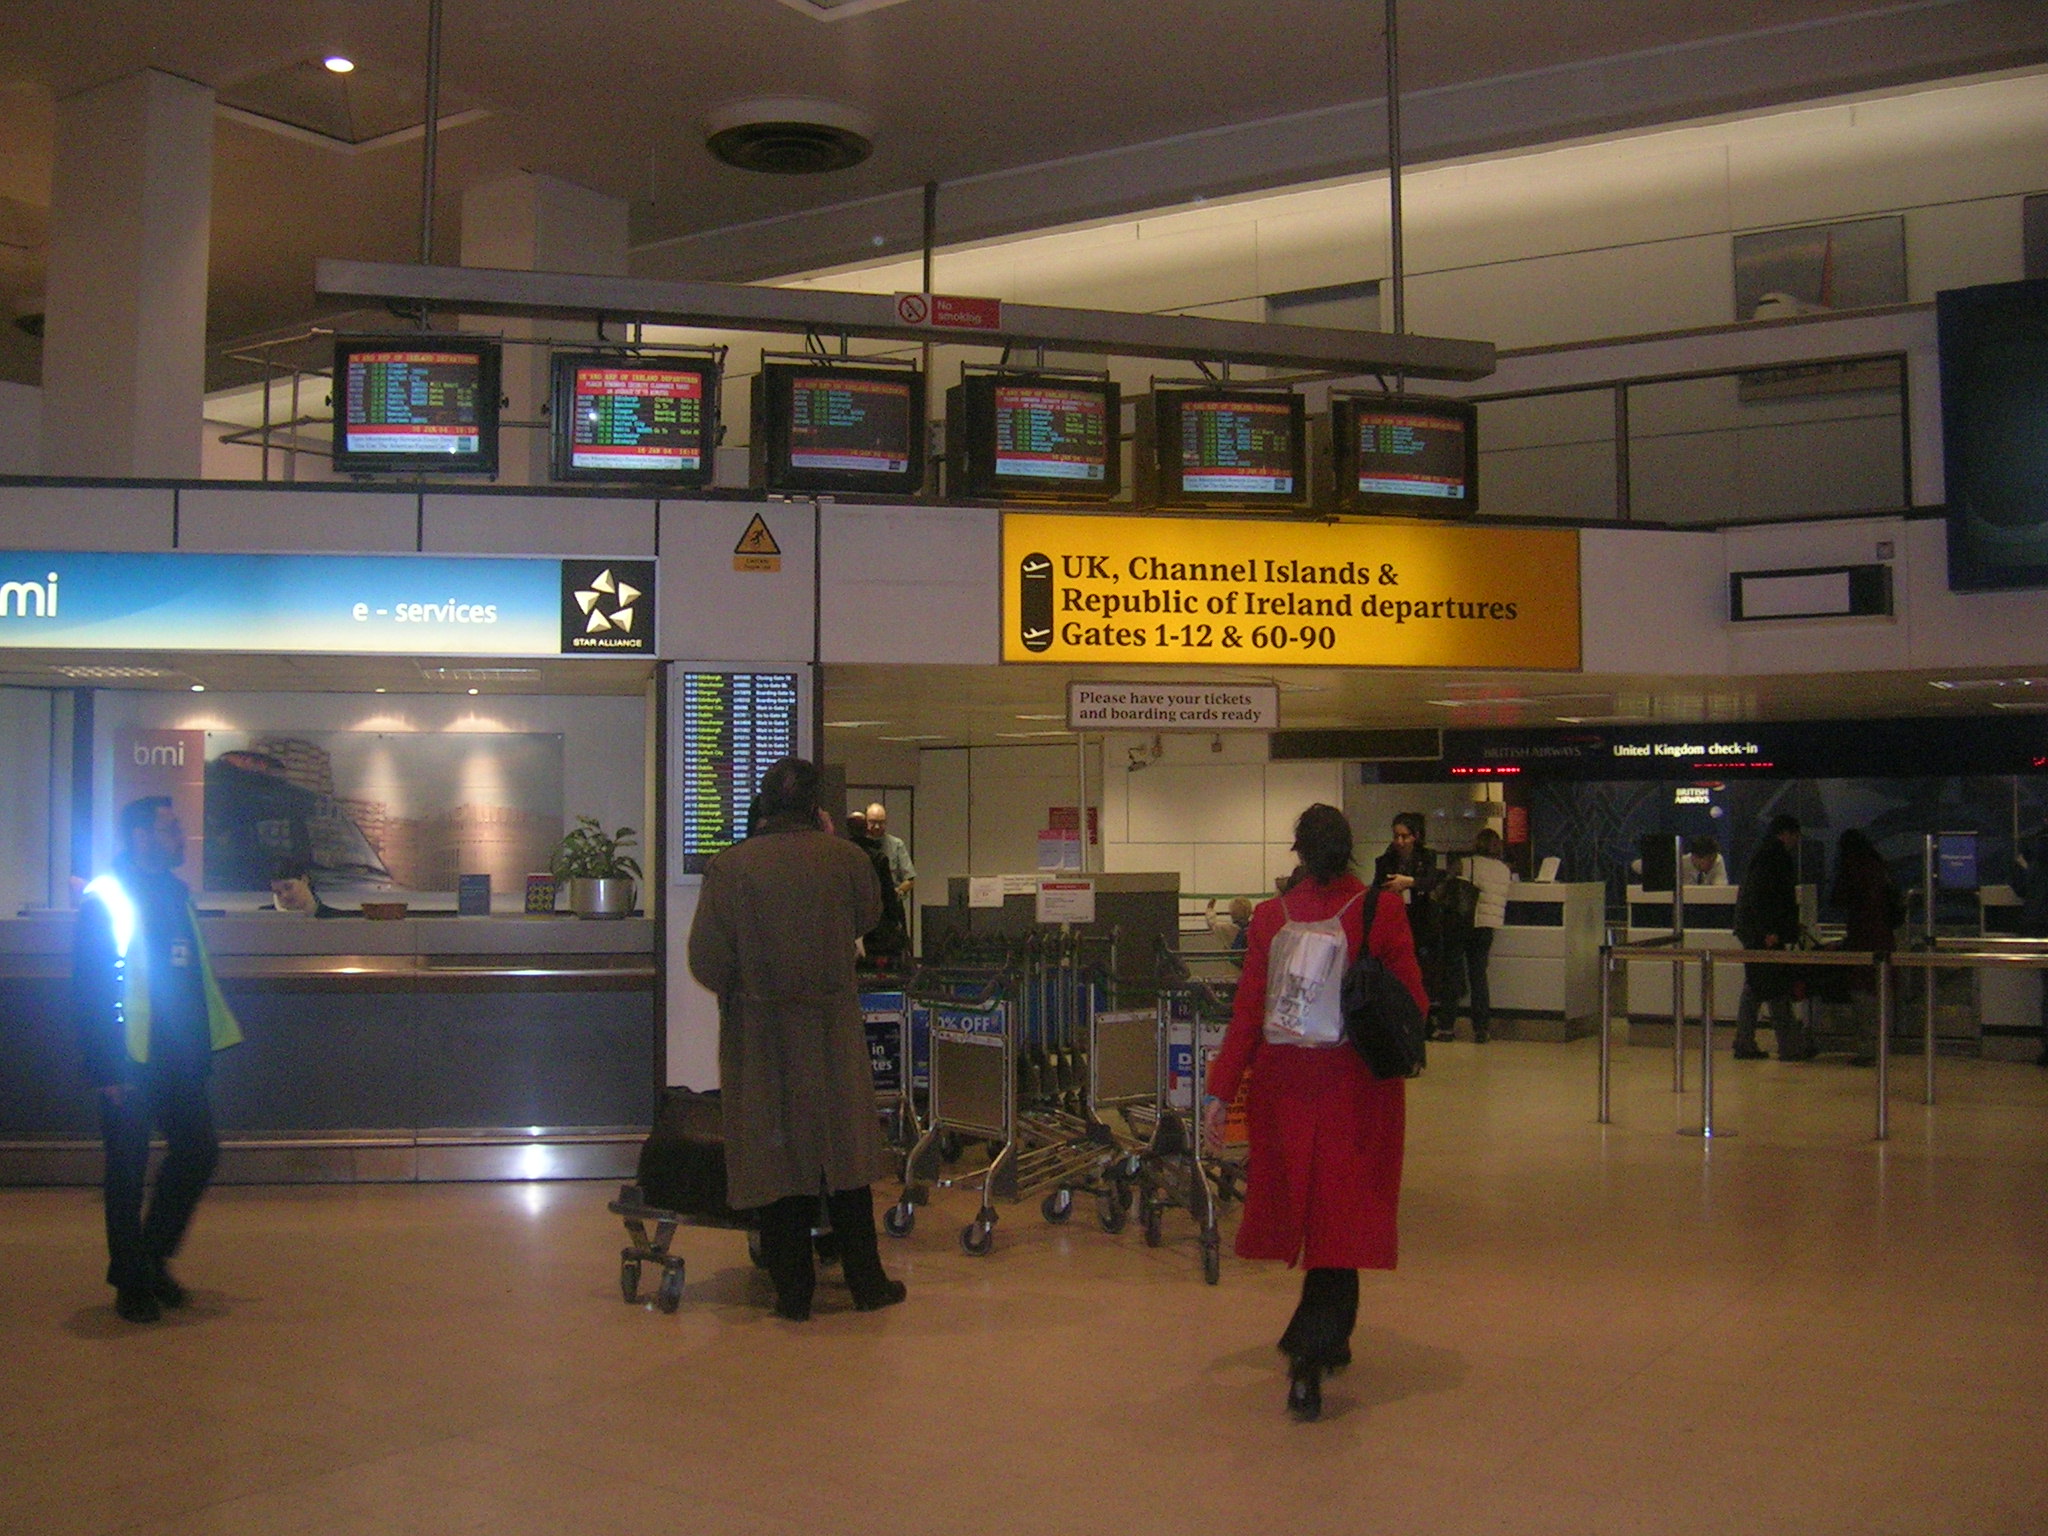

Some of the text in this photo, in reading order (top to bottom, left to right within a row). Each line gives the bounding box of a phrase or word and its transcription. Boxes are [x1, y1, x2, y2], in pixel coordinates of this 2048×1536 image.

[937, 300, 952, 310] No
[938, 312, 981, 324] smoking
[1061, 555, 1399, 586] UK, Channel Islands &
[395, 598, 497, 624] services
[1061, 588, 1518, 625] Republic of Ireland departures
[572, 638, 642, 648] STAR ALLIANCE
[1061, 621, 1336, 651] Gates 1-12 & 60-90
[1079, 691, 1252, 708] Please have your tickets
[1079, 707, 1261, 723] and boarding cards ready
[133, 740, 185, 767] bmi
[1613, 741, 1758, 757] United Kingdom check-in
[1675, 787, 1710, 796] BRITISH
[961, 1015, 989, 1032] OFF
